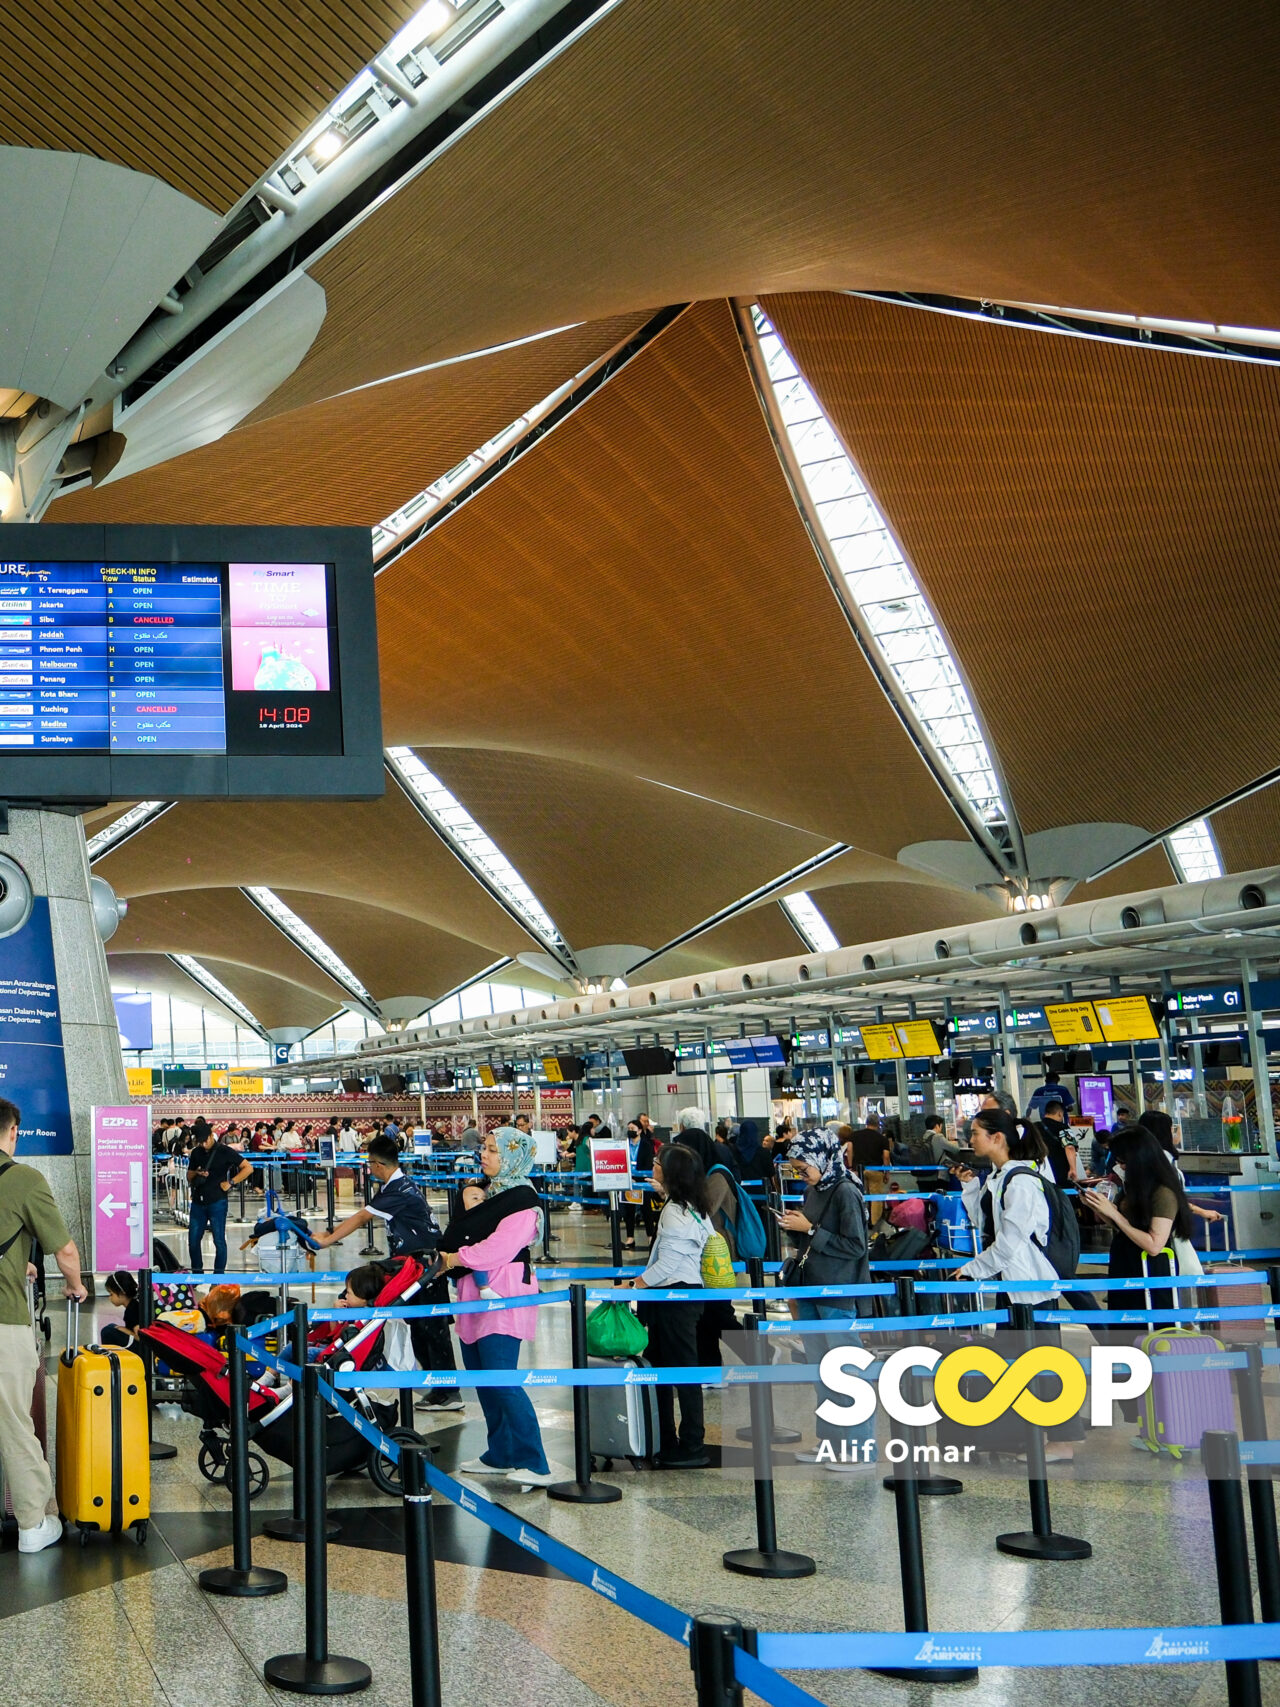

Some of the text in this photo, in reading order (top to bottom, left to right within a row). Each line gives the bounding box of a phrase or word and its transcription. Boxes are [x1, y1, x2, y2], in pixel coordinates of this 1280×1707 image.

[260, 708, 310, 722] 14:08
[14, 980, 55, 990] Antarabangsa
[18, 989, 50, 997] Departures
[1198, 994, 1214, 1002] Masuk
[1224, 991, 1238, 1005] G1
[37, 1010, 56, 1018] Negeri
[985, 1017, 996, 1029] G3
[277, 1047, 287, 1058] G
[102, 1118, 138, 1126] EZPaz
[1162, 1646, 1210, 1656] AIRPORTS
[933, 1652, 982, 1661] AIRPORTS
